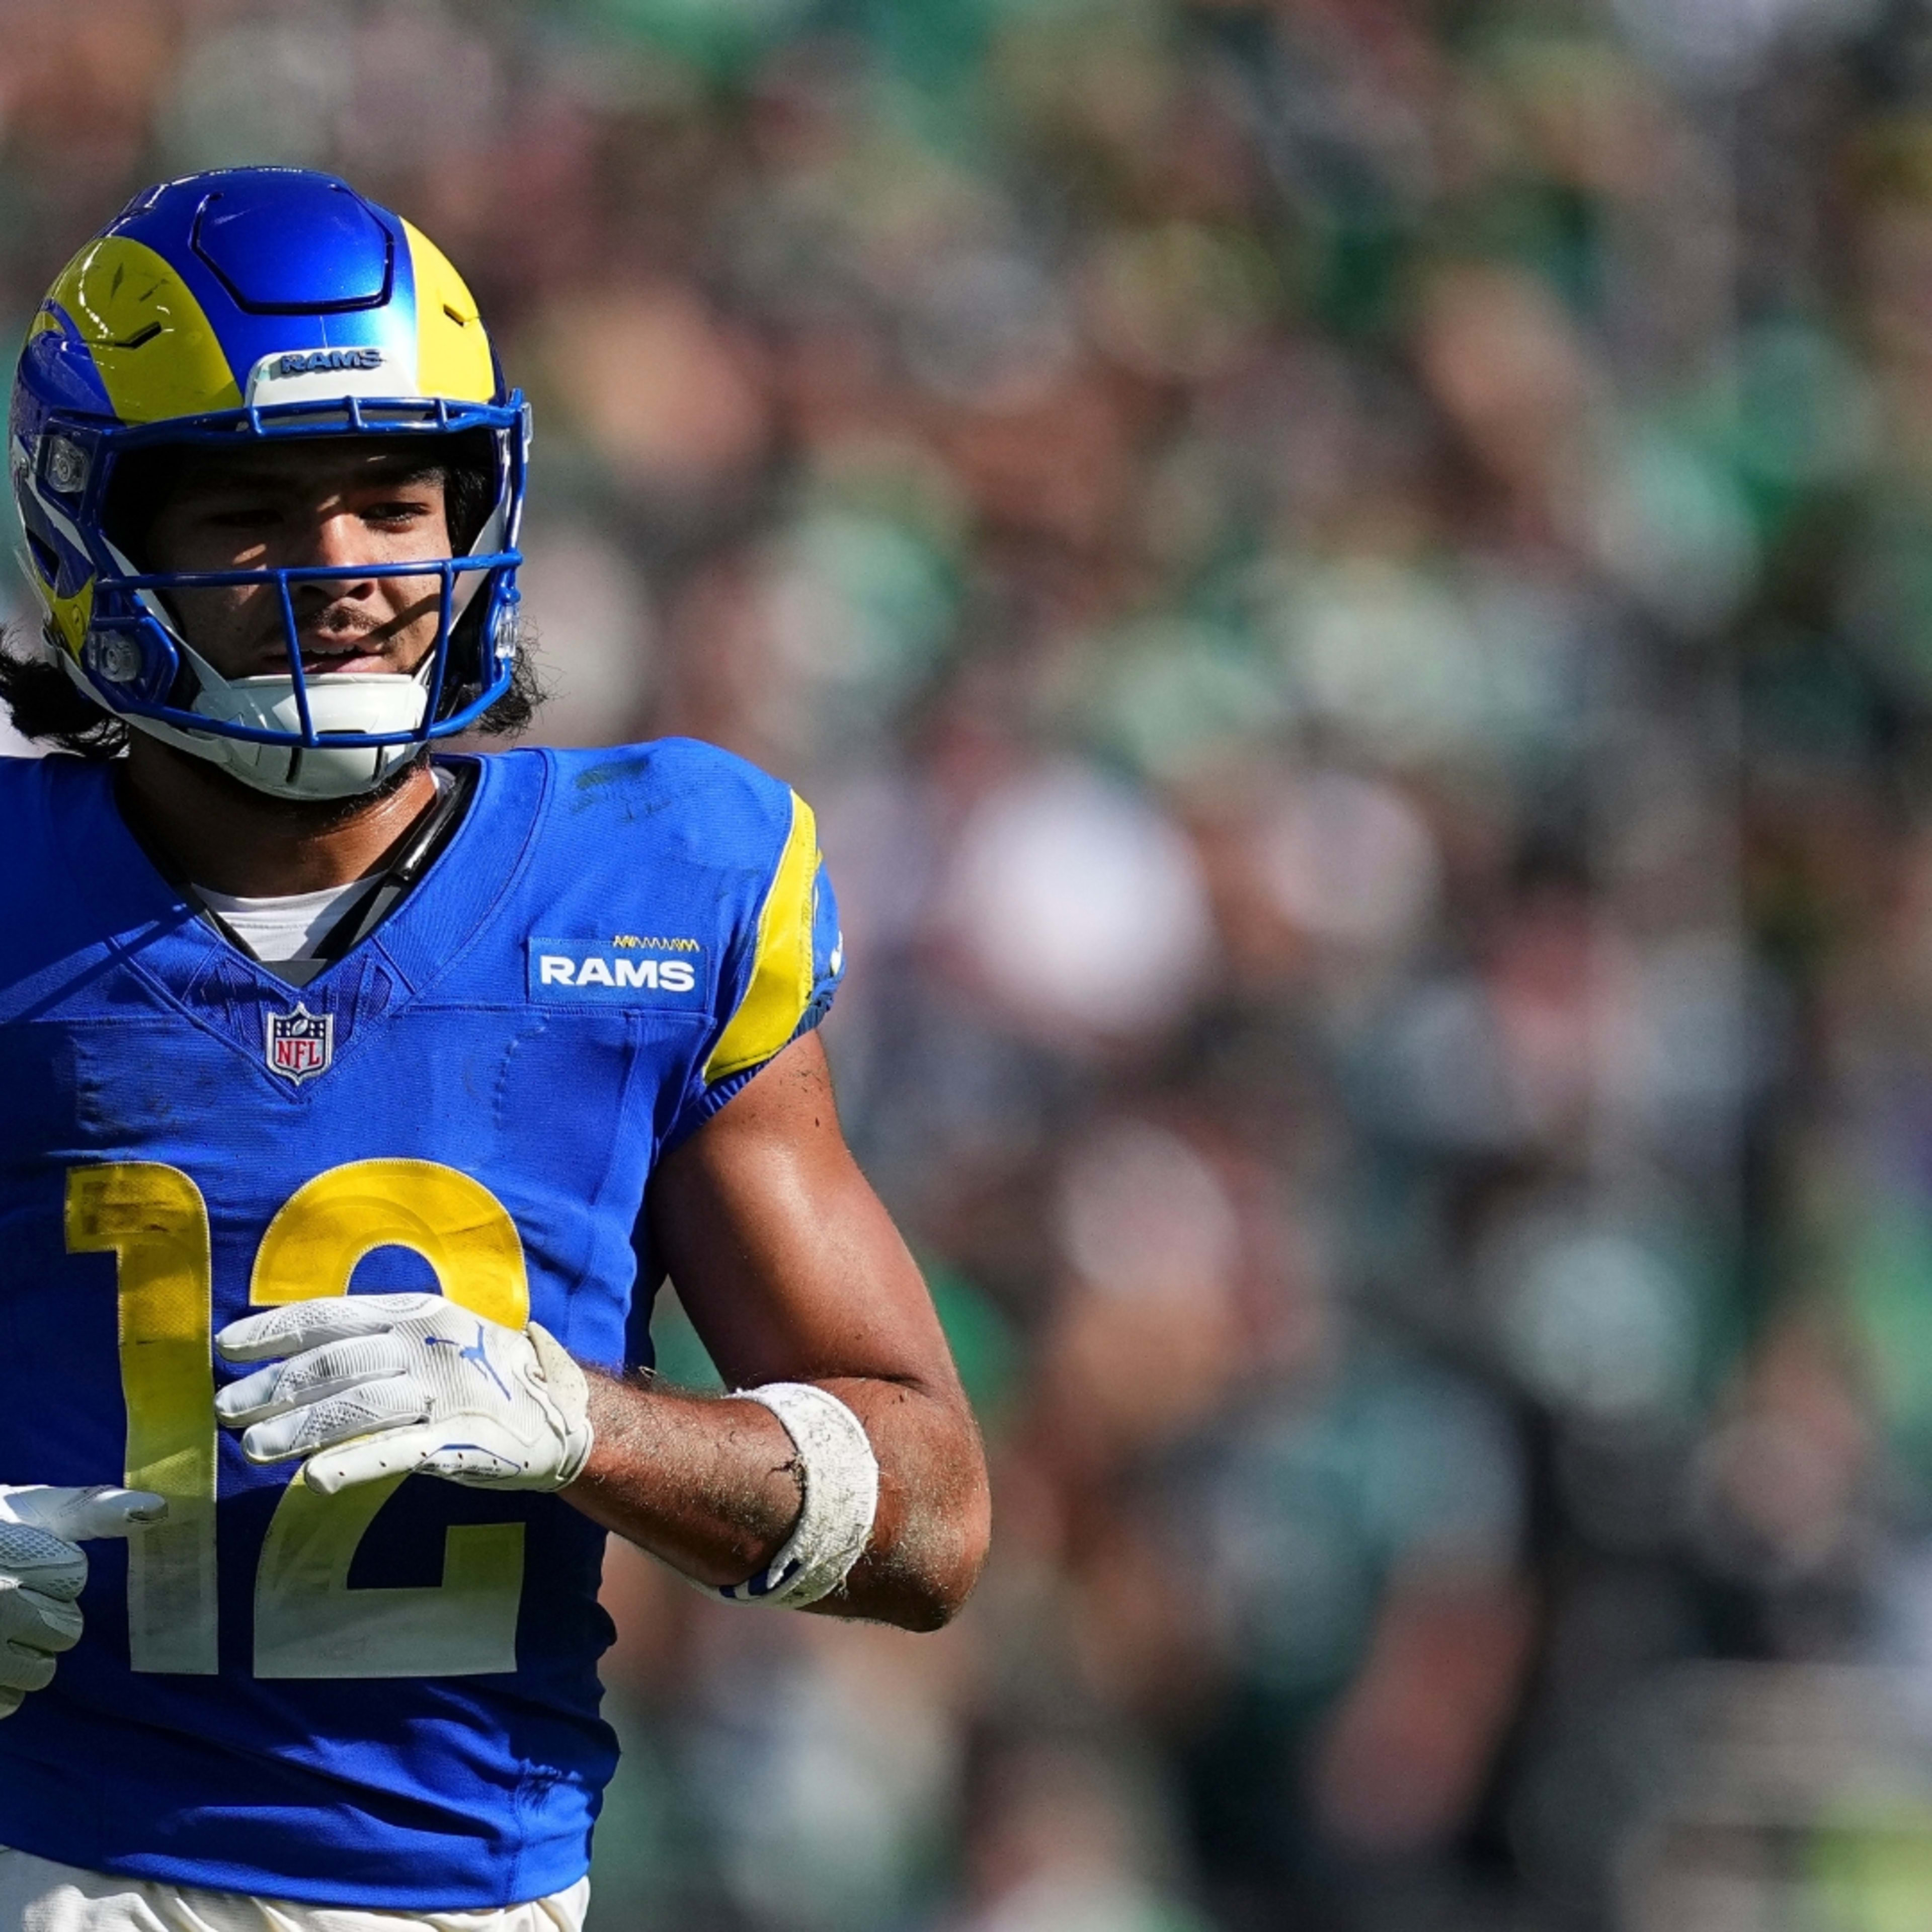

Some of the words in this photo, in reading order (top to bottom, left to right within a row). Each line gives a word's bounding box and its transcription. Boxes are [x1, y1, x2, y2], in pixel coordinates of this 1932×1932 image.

[281, 349, 381, 373] RAMS
[540, 955, 695, 992] RAMS
[277, 1040, 320, 1069] NFL
[64, 1157, 530, 1678] 12
